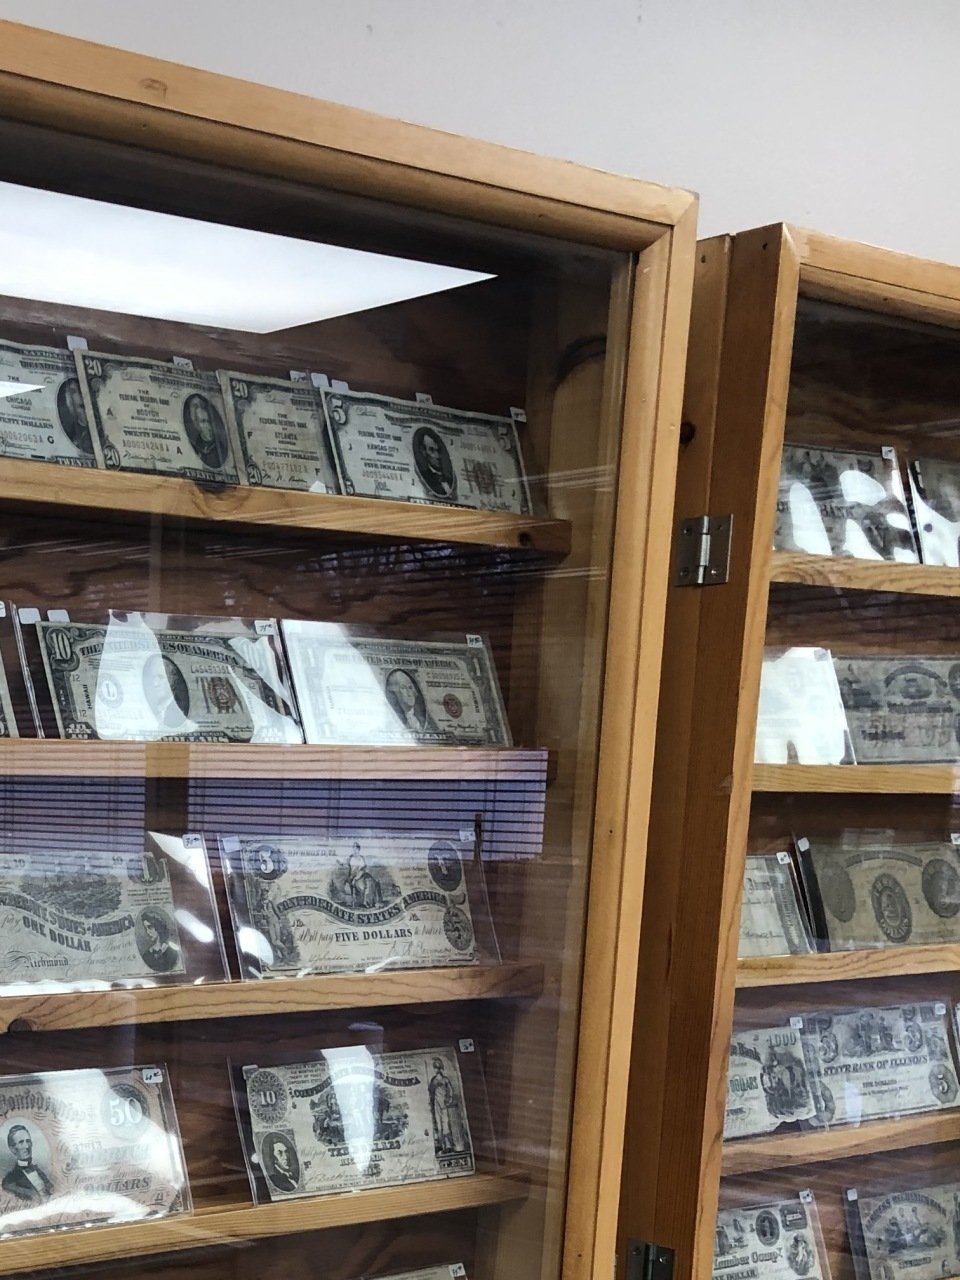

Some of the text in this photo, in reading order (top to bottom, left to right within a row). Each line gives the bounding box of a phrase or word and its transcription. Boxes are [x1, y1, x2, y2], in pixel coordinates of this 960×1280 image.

[86, 360, 102, 377] 20
[232, 381, 248, 398] 20
[332, 399, 346, 424] 5
[51, 631, 71, 660] 10
[277, 890, 447, 925] CONFEDERATE STATES AMERICA
[335, 928, 413, 943] FIVE DOLLARS
[937, 1074, 949, 1094] 5
[260, 1091, 277, 1106] 10
[109, 1097, 142, 1126] 50
